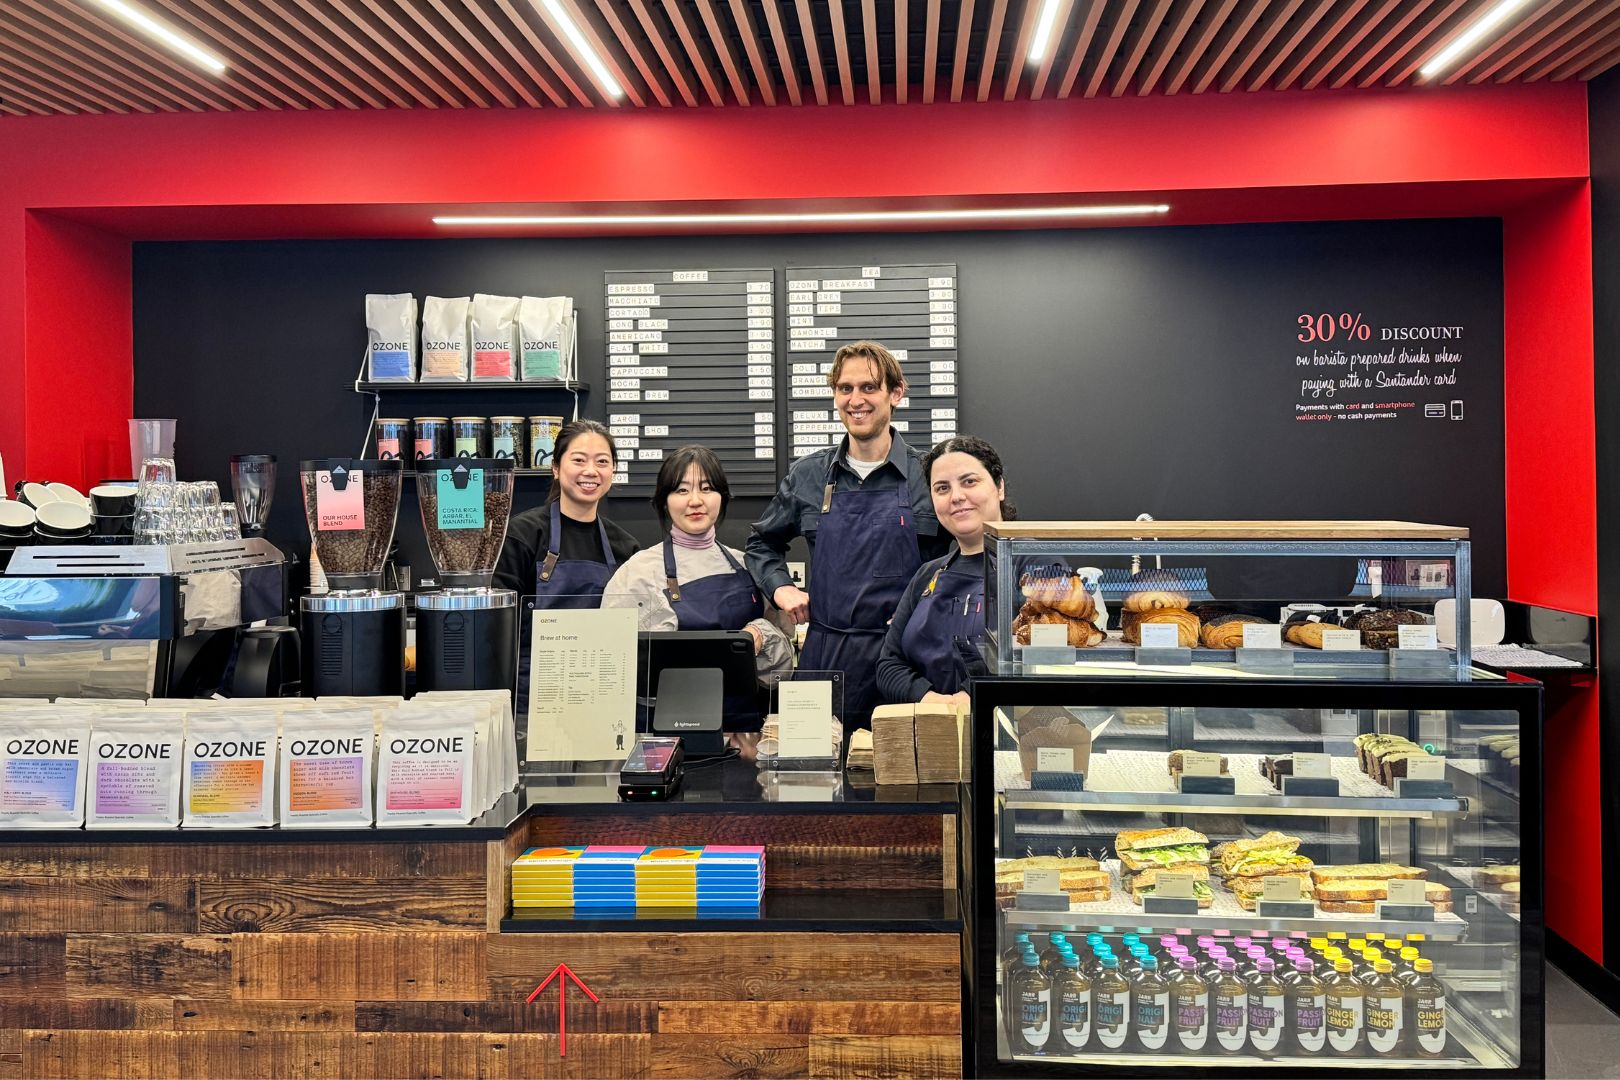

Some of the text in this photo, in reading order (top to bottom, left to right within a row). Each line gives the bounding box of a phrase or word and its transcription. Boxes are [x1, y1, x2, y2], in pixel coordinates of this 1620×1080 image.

[862, 268, 880, 276] TEA
[608, 285, 654, 293] ESPRESSO
[609, 297, 660, 305] MACCHIATO
[817, 293, 840, 301] GREY
[609, 309, 650, 317] CORTADO
[817, 305, 841, 313] TIPS
[610, 321, 633, 329] LONG
[1297, 312, 1464, 342] 30% DISCOUNT
[791, 329, 837, 337] CAMOMILE
[372, 342, 408, 350] OZONE
[426, 342, 460, 350] OZONE
[475, 342, 509, 350] OZONE
[524, 342, 558, 350] OZONE
[791, 341, 825, 349] MATCHA
[610, 356, 639, 364] LATTE
[1296, 346, 1462, 371] on barista prepared drinks when
[611, 380, 640, 388] MOCHA
[1302, 368, 1456, 398] paying with a Santander card
[1296, 404, 1328, 412] Payments
[1375, 402, 1416, 410] smartphone
[610, 415, 640, 423] LARGE
[794, 412, 828, 420] DELUXE
[1316, 414, 1332, 422] only
[1364, 412, 1397, 421] payments
[610, 427, 638, 435] EXTRA
[7, 740, 78, 754] OZONE
[290, 738, 363, 756] OZONE
[390, 737, 464, 754] OZONE
[99, 744, 171, 758] OZONE
[194, 742, 266, 758] OZONE
[1216, 1017, 1240, 1025] FRUIT
[1298, 1018, 1320, 1026] FRUIT
[1327, 1015, 1355, 1027] LEMON
[1367, 1016, 1394, 1027] LEMON
